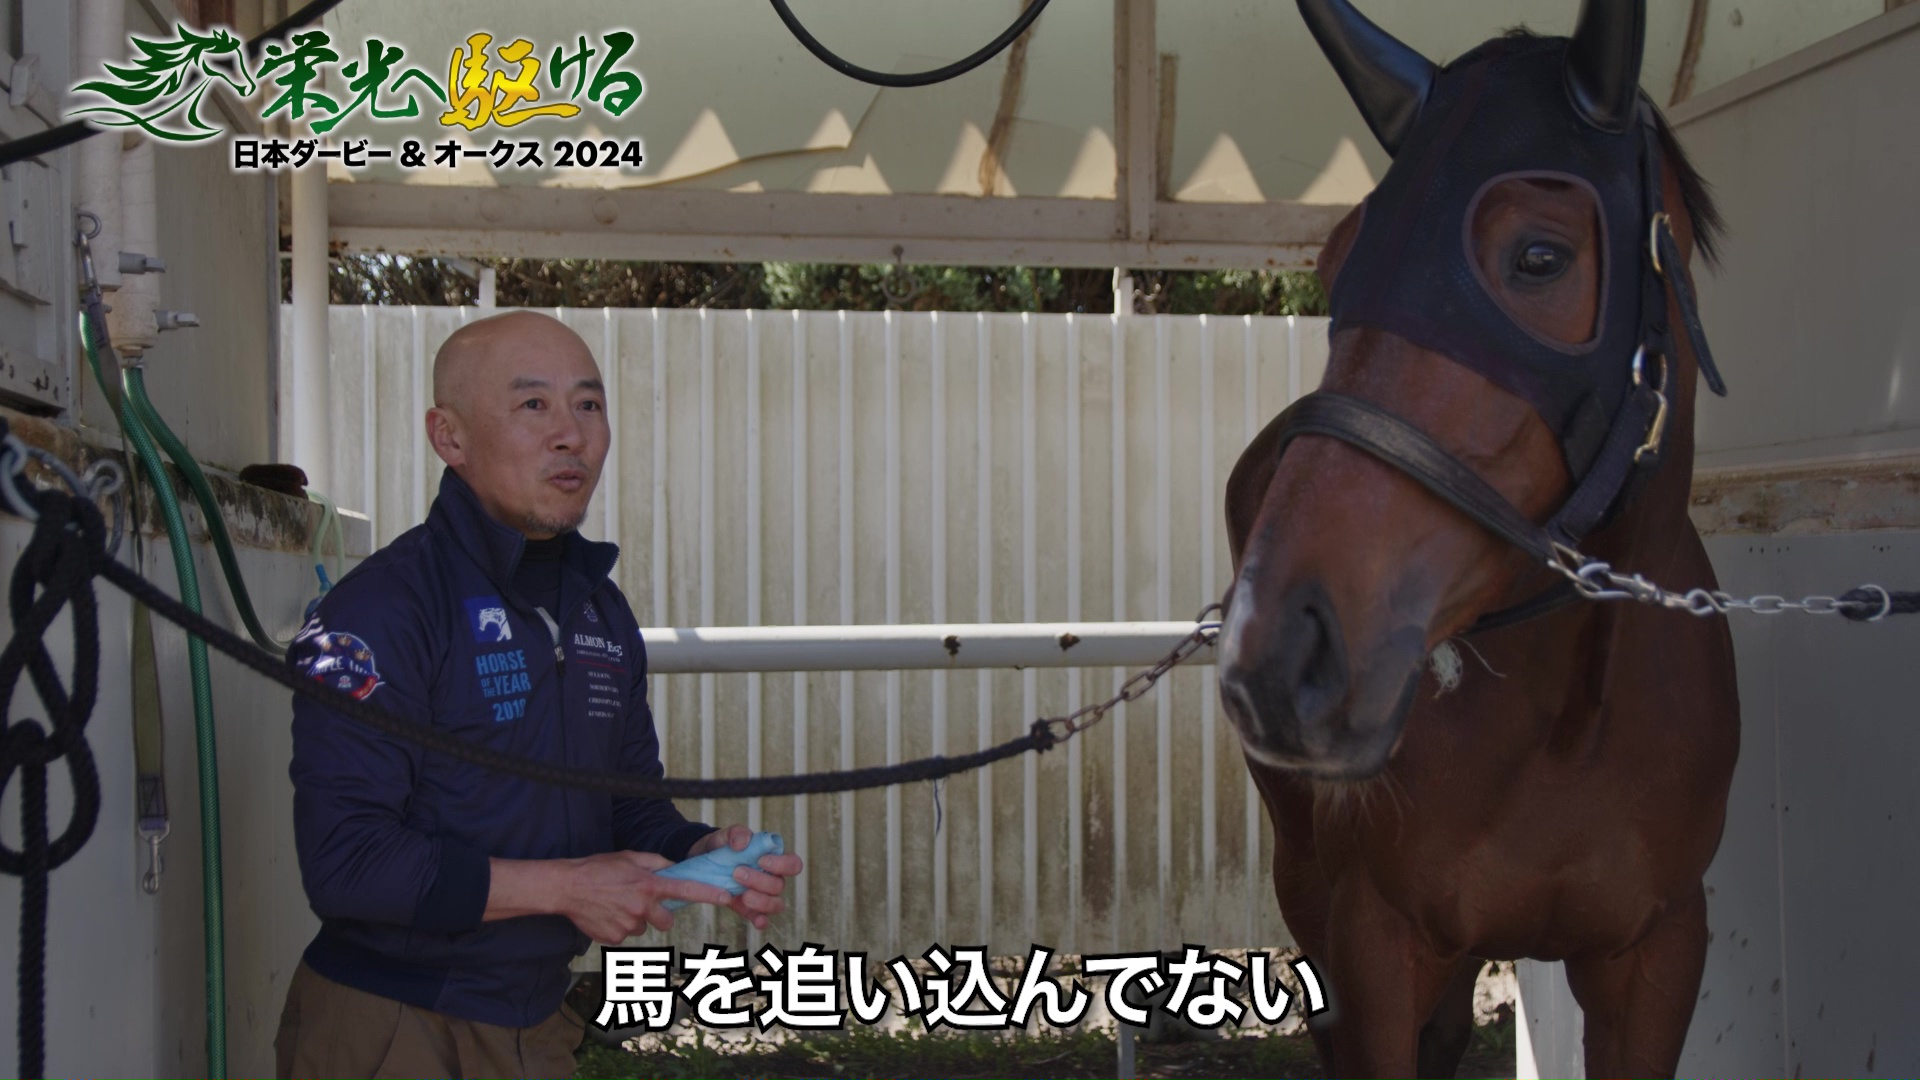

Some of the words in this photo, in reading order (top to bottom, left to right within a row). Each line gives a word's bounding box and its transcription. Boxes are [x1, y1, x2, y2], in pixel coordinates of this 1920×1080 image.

[475, 649, 528, 676] HORSE
[480, 677, 492, 688] OF
[493, 672, 533, 697] YEAR
[482, 687, 497, 699] THE
